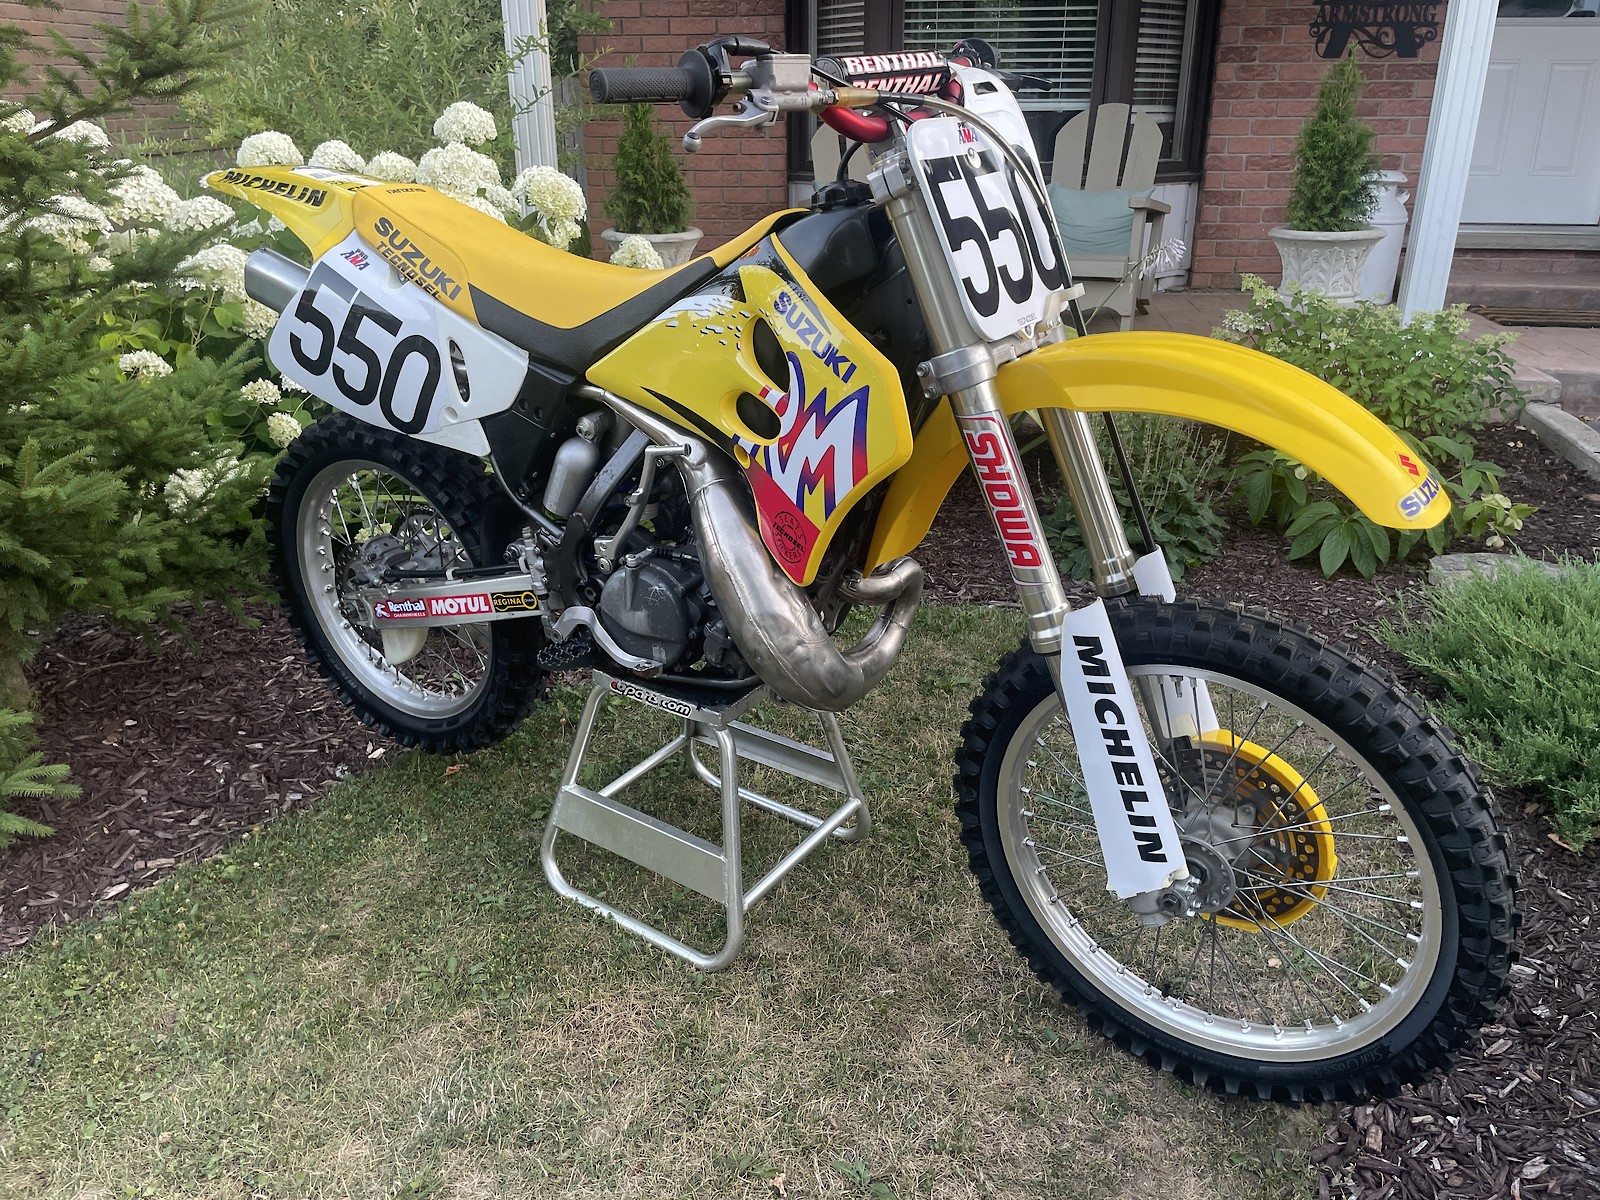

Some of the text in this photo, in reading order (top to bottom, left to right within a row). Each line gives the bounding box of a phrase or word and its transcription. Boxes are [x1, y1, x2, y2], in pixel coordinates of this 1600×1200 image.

[1316, 4, 1437, 23] ARMSTRONG
[843, 51, 944, 74] RENTHAL
[218, 170, 328, 207] MICHELIN
[374, 216, 463, 301] SUZUKI
[919, 145, 1066, 317] 550
[376, 240, 442, 300] TECNOSEL
[289, 261, 441, 434] 550
[774, 291, 858, 384] SUZUKI
[964, 430, 1043, 568] SHOWA
[388, 599, 426, 613] Renthal
[432, 596, 489, 615] MOTUL
[493, 597, 522, 606] REGINA
[1072, 634, 1168, 864] MICHELIN
